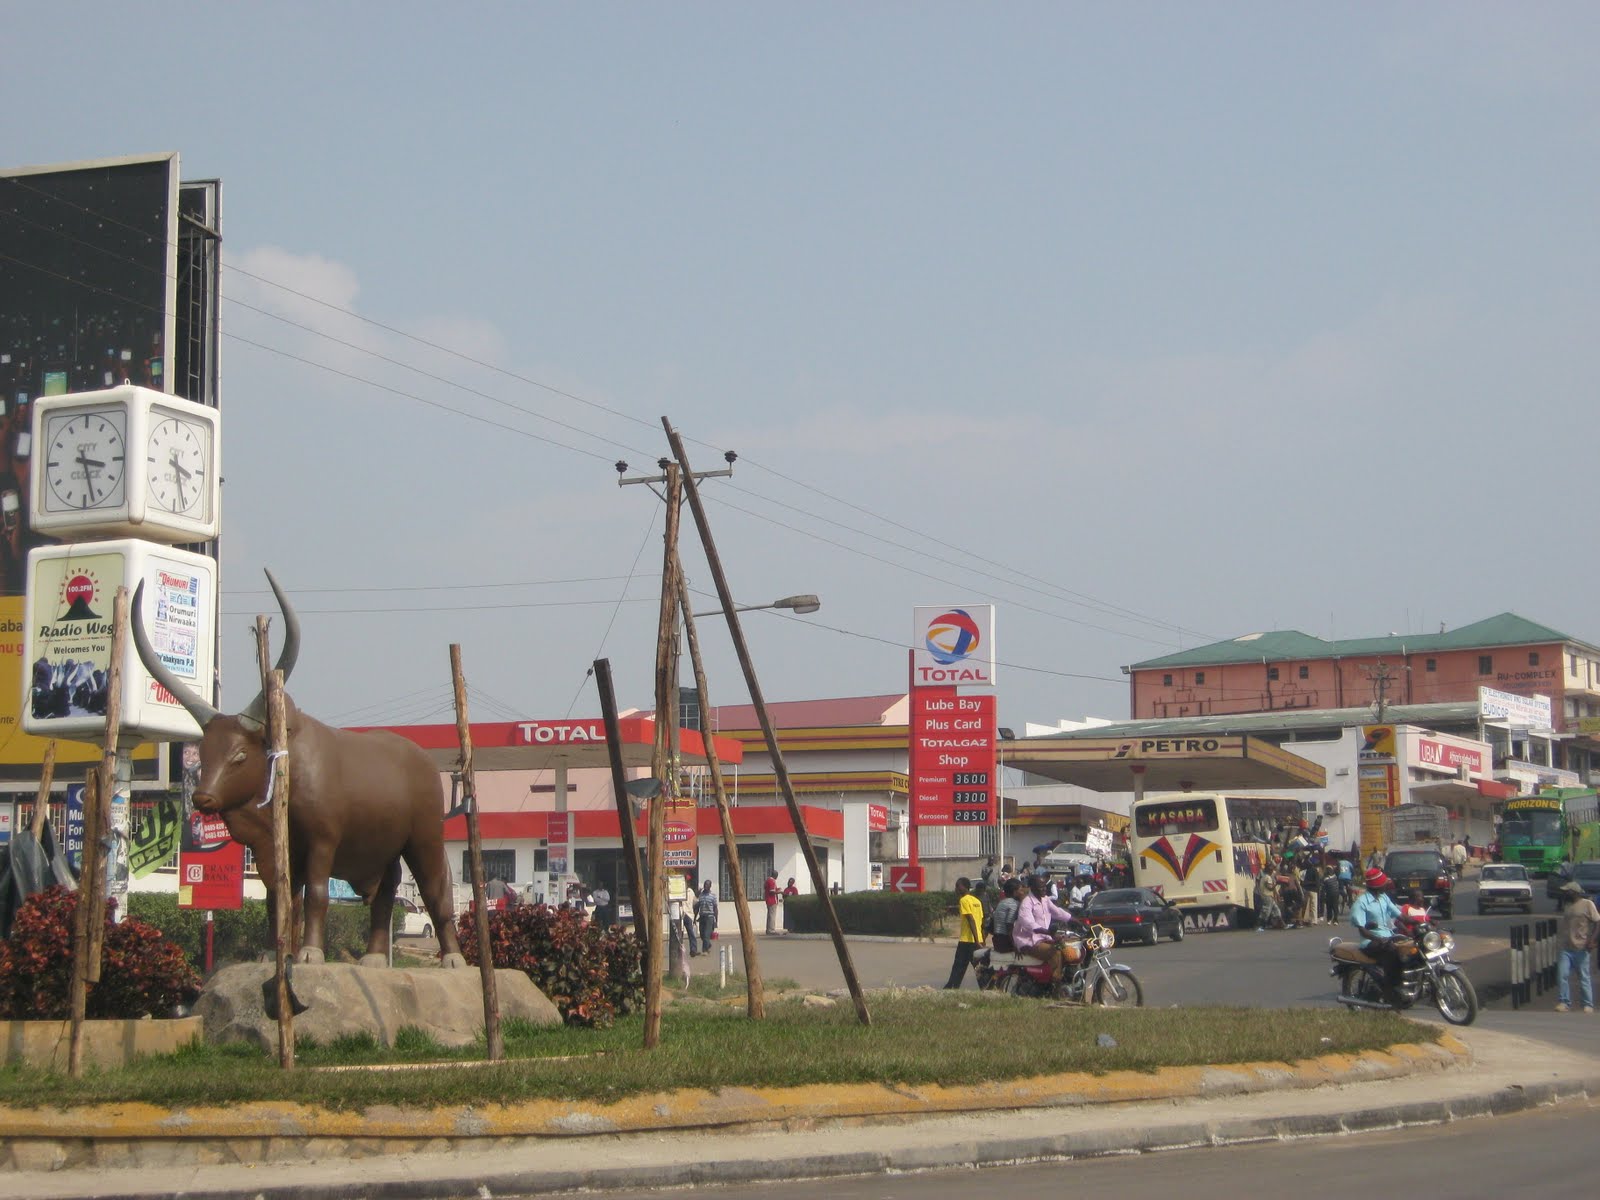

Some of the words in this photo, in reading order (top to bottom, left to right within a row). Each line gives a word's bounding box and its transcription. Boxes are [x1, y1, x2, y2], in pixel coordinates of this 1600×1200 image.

[68, 584, 93, 592] 100.2FM
[170, 605, 197, 617] Orumuri
[168, 615, 196, 628] Nirwaaka
[40, 624, 82, 637] Radio
[86, 622, 113, 635] Wes
[53, 646, 90, 655] Welcomes
[918, 667, 988, 681] TOTAL
[925, 699, 954, 710] Lube
[959, 699, 981, 712] Bay
[925, 719, 949, 730] Plus
[954, 718, 982, 729] Card
[518, 723, 606, 743] TOTAL
[920, 738, 988, 748] TOTALGAZ
[1141, 739, 1219, 753] PETRO
[1421, 743, 1436, 763] UBA
[938, 754, 969, 768] Shop
[955, 773, 987, 785] 3600
[955, 792, 987, 804] 3300
[1507, 799, 1549, 810] HORIZON
[955, 810, 987, 822] 2850
[679, 858, 696, 866] News
[1184, 912, 1230, 929] AMA
